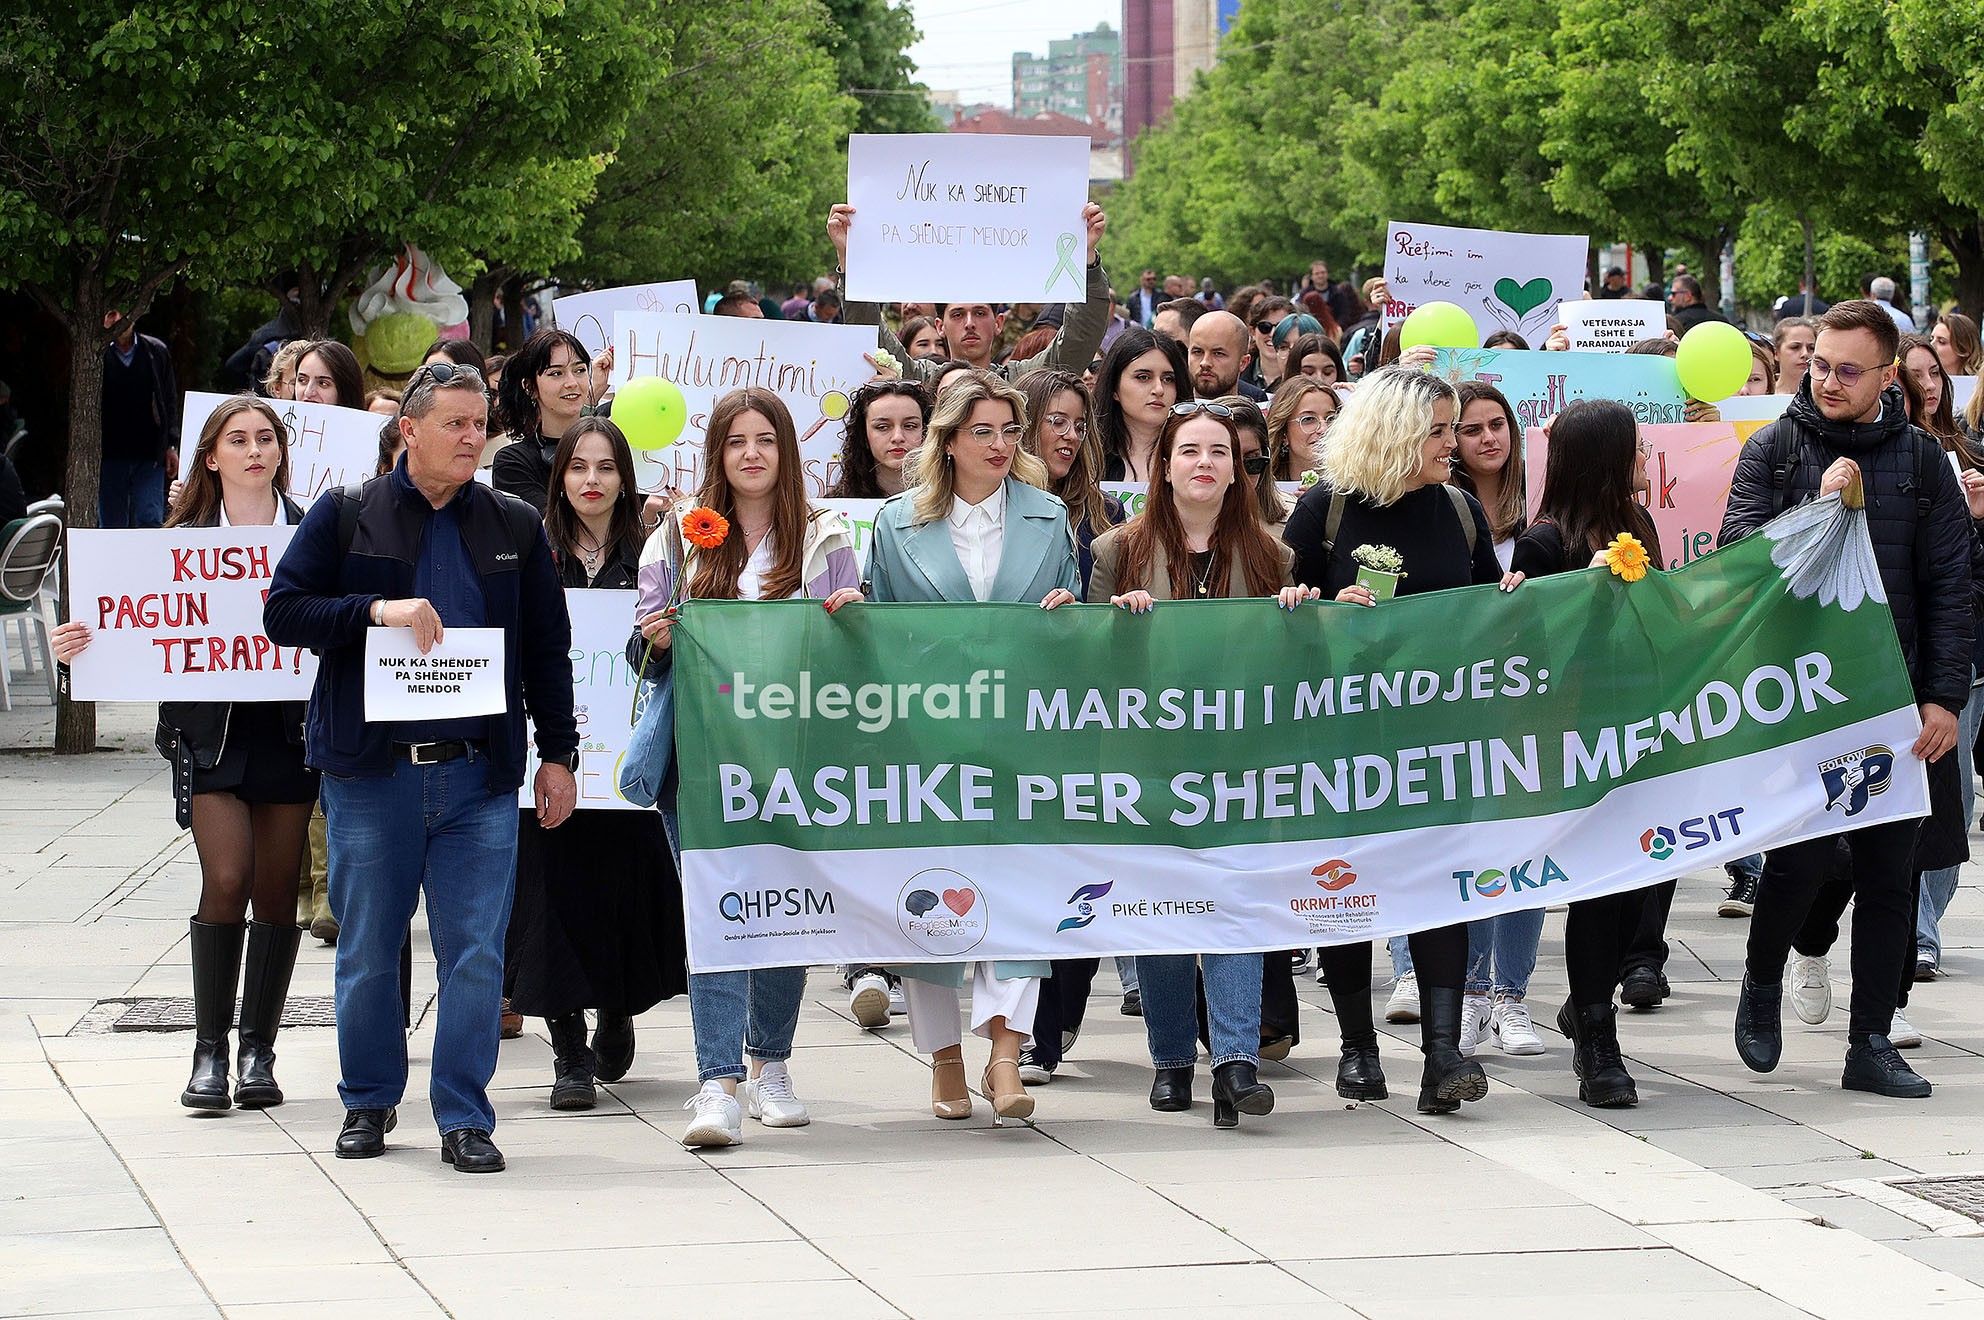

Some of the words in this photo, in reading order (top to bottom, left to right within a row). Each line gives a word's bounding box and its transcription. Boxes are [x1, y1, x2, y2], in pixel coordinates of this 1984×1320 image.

[948, 183, 966, 202] KA
[973, 183, 1028, 204] SHËNDET
[881, 223, 902, 244] PA
[907, 222, 967, 246] SHËNDET
[972, 226, 1029, 247] MENDOR
[1467, 249, 1484, 260] im
[1394, 266, 1409, 285] ka
[1628, 329, 1635, 338] E
[627, 329, 820, 398] Hulumtimi
[170, 545, 272, 582] KUSH
[97, 592, 209, 630] PAGUN
[379, 657, 406, 667] NUK
[410, 658, 428, 667] KA
[431, 656, 490, 668] SHËNDET
[395, 671, 411, 680] PA
[414, 669, 473, 681] SHËNDET
[407, 684, 461, 694] MENDOR
[1025, 687, 1245, 731] MARSHI
[1263, 684, 1274, 725] I
[1293, 655, 1550, 721] MENDJES:
[718, 763, 994, 827] BASHKE
[1016, 772, 1151, 827] PER
[1168, 734, 1542, 828] SHENDETIN
[1562, 651, 1850, 789] MENDOR
[1819, 750, 1866, 774] FOLLOW
[1678, 806, 1745, 851] SIT
[1452, 853, 1570, 902] TOKA
[719, 888, 835, 925] QHPSM
[1112, 899, 1148, 917] PIKË
[1153, 900, 1216, 916] KTHESE
[1290, 894, 1377, 913] QKRMT-KRCT
